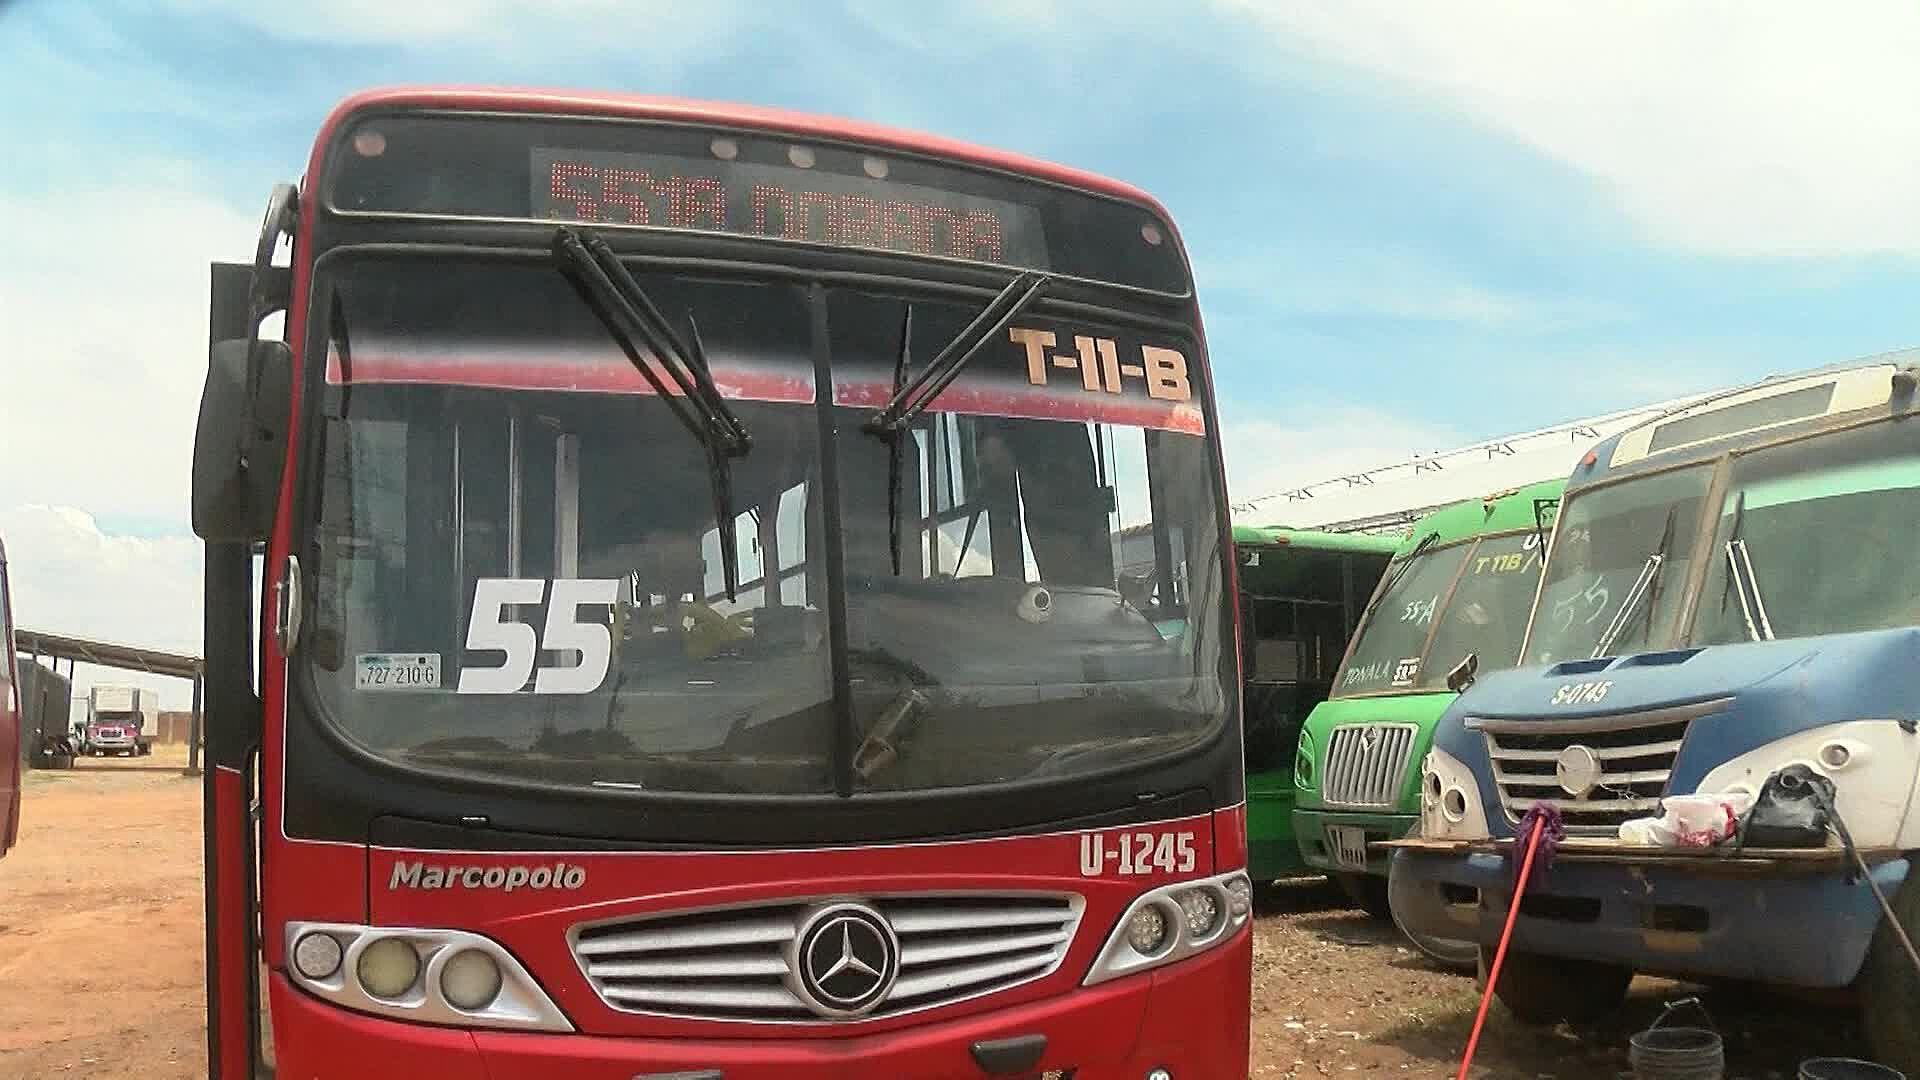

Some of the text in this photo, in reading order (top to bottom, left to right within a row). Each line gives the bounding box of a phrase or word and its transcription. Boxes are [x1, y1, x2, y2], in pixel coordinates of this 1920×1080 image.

[1009, 327, 1192, 401] T-11-B
[456, 578, 621, 694] 55
[389, 861, 586, 891] Marcopolo
[1080, 832, 1195, 876] U-1245
